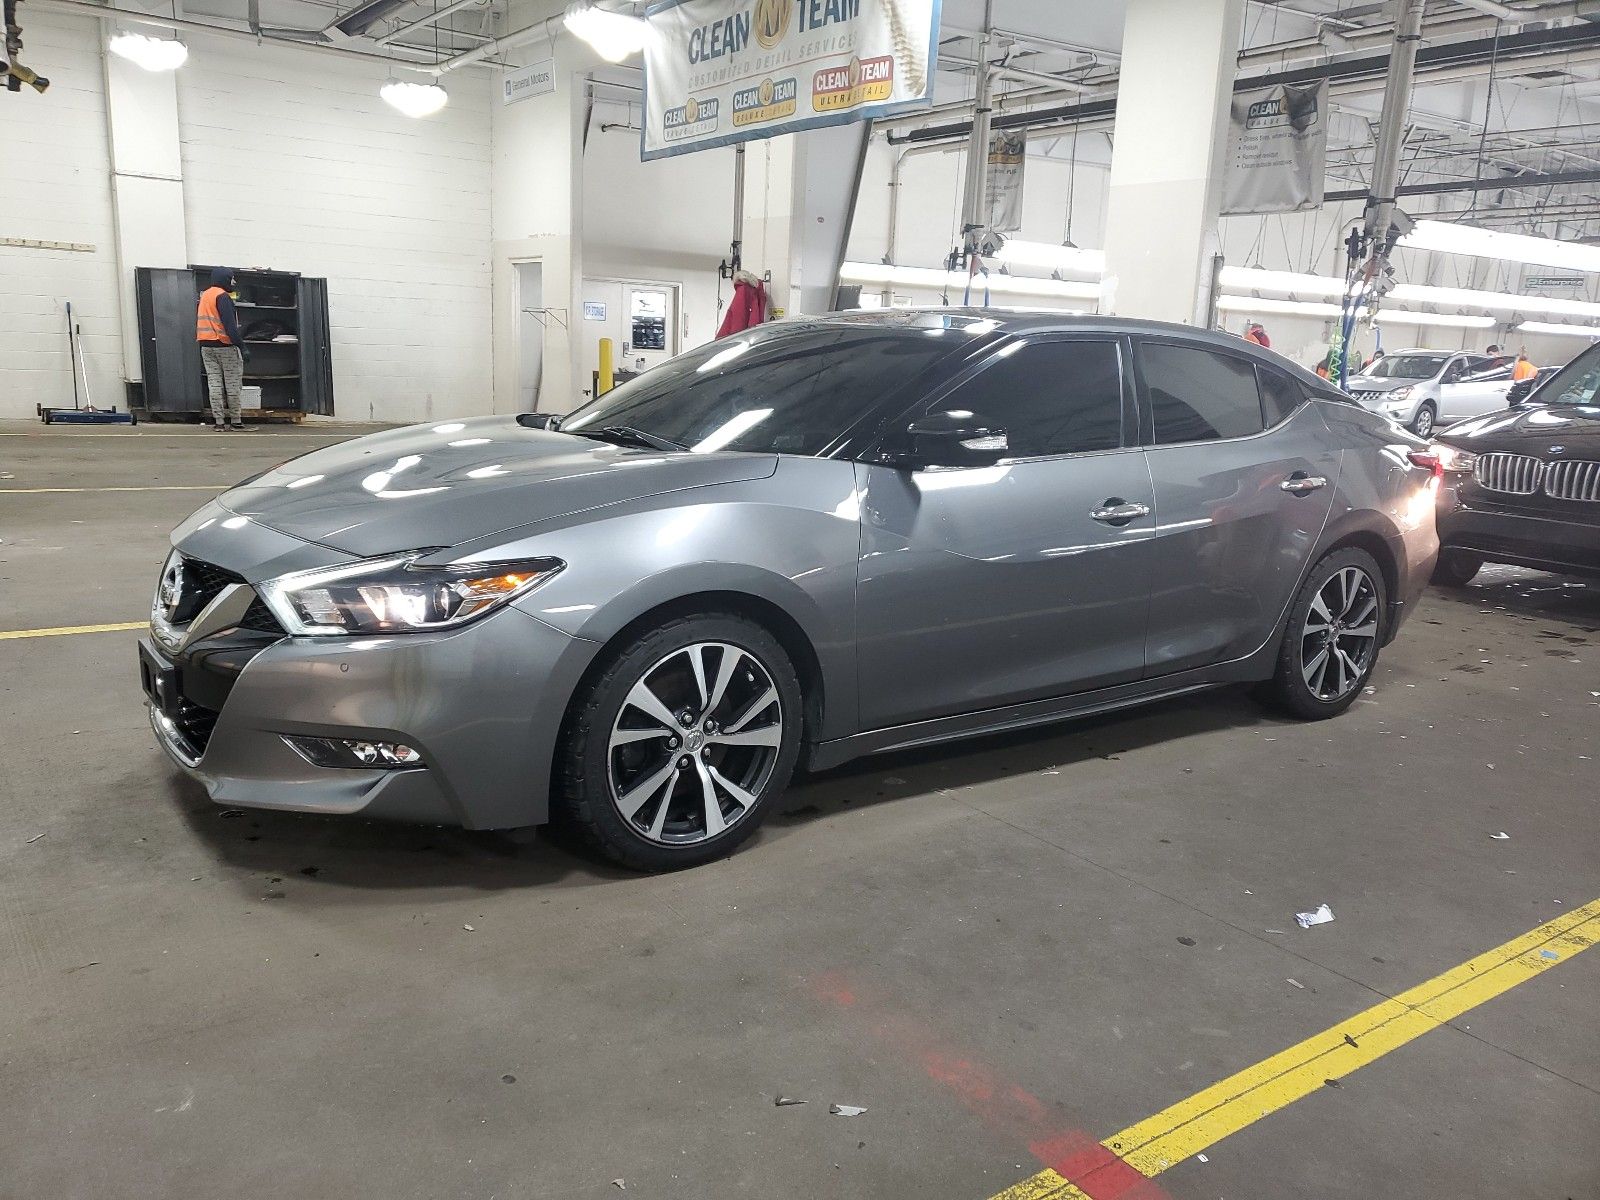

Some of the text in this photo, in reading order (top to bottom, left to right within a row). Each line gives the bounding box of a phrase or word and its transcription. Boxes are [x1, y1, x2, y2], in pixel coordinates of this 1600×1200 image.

[687, 10, 750, 65] CLEAN
[755, 48, 791, 71] DETAIL
[816, 60, 890, 91] CLEAN TEAM
[734, 80, 796, 110] CLEAN TEAM
[820, 94, 851, 106] ULTRA
[665, 101, 718, 126] CLEAN TEAM
[1250, 102, 1279, 116] CLEAN
